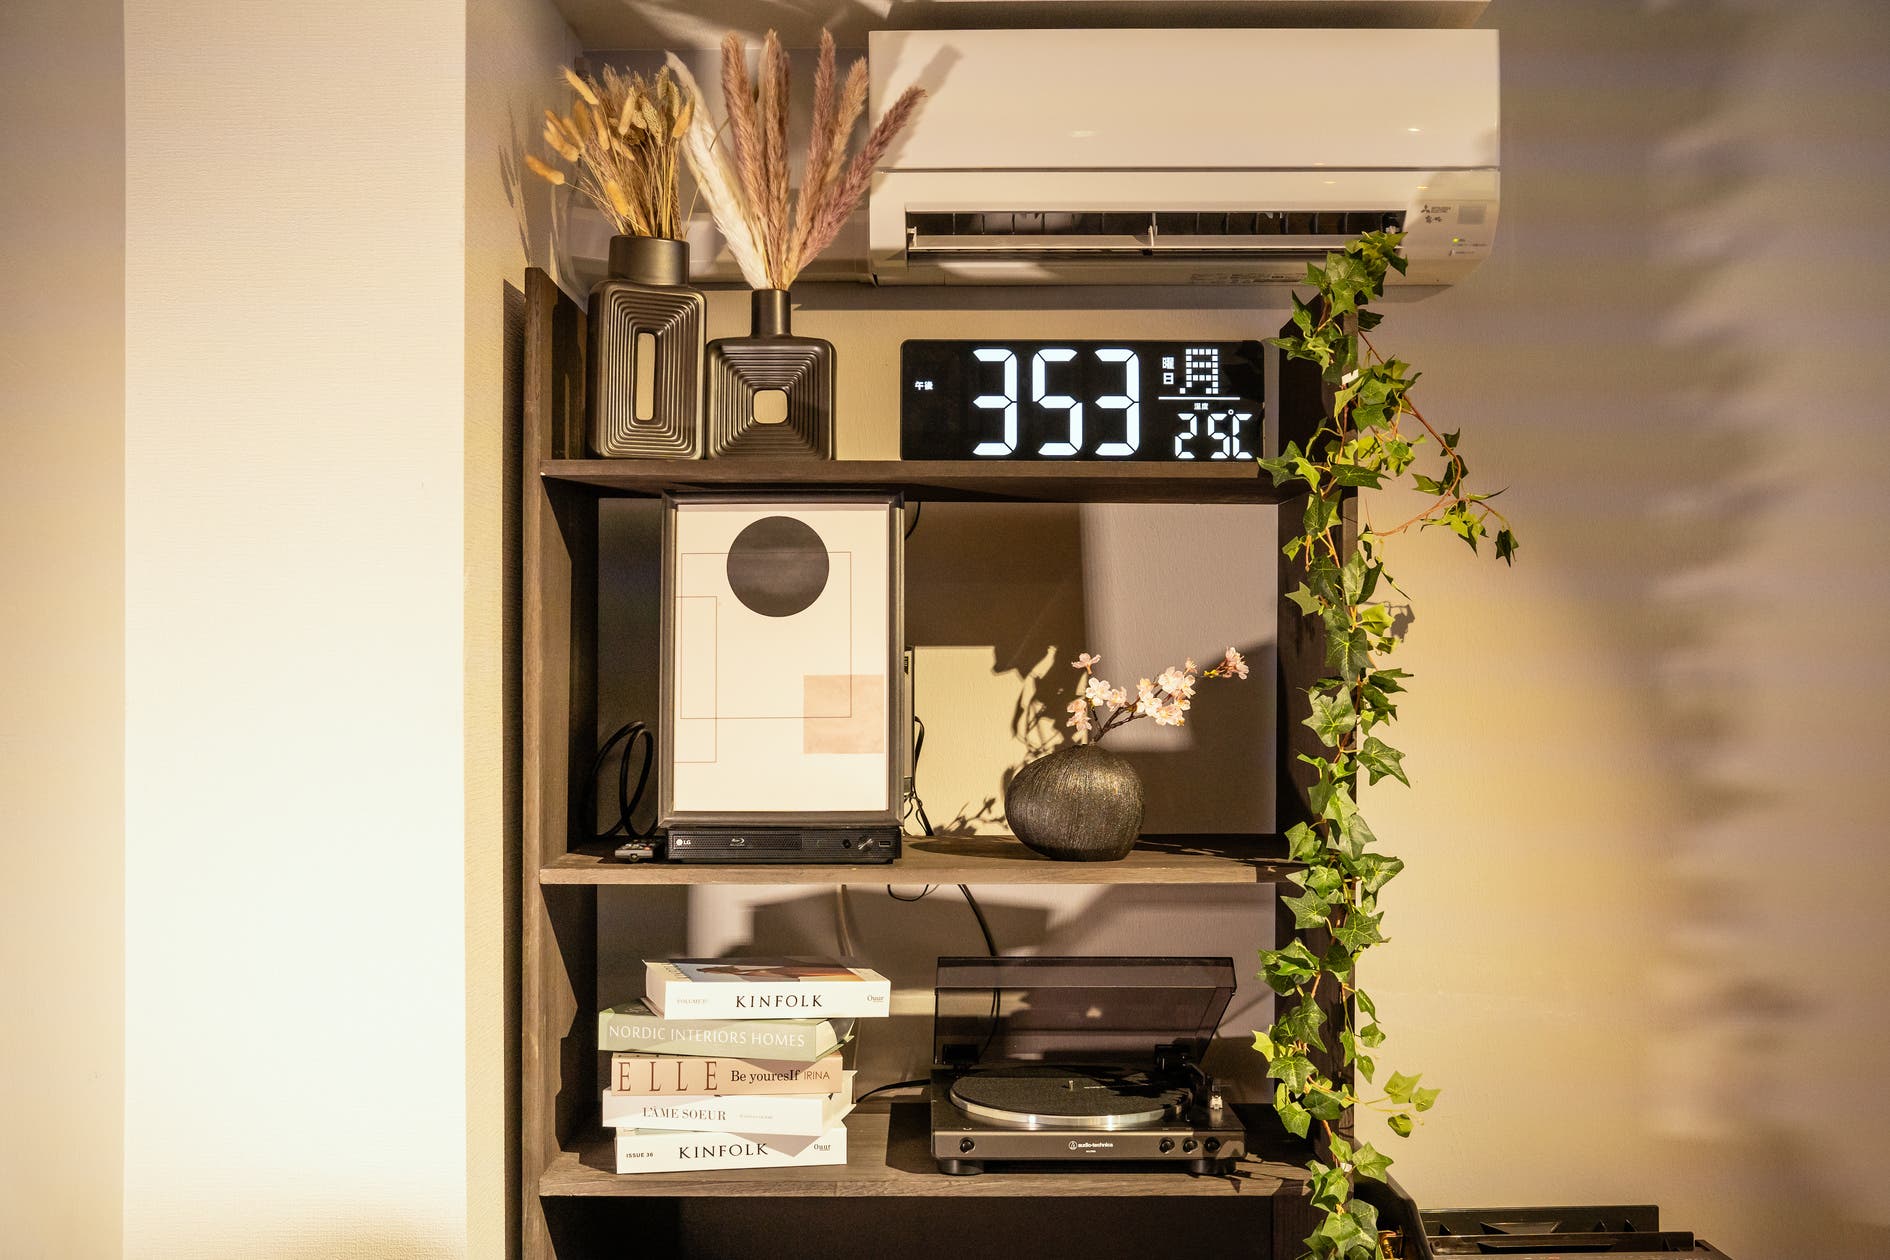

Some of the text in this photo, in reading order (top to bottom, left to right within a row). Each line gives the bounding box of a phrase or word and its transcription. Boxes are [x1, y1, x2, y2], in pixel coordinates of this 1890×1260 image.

[1179, 348, 1218, 394] 月
[914, 381, 933, 390] 午後
[736, 995, 823, 1008] KINFOLK
[609, 1025, 805, 1048] NORDIC INTERIORS HOMES
[617, 1061, 718, 1092] ELLE
[731, 1070, 747, 1081] Be
[803, 1070, 830, 1080] IRINA
[682, 1108, 726, 1121] SOEUR
[679, 1143, 768, 1159] KINFOLK
